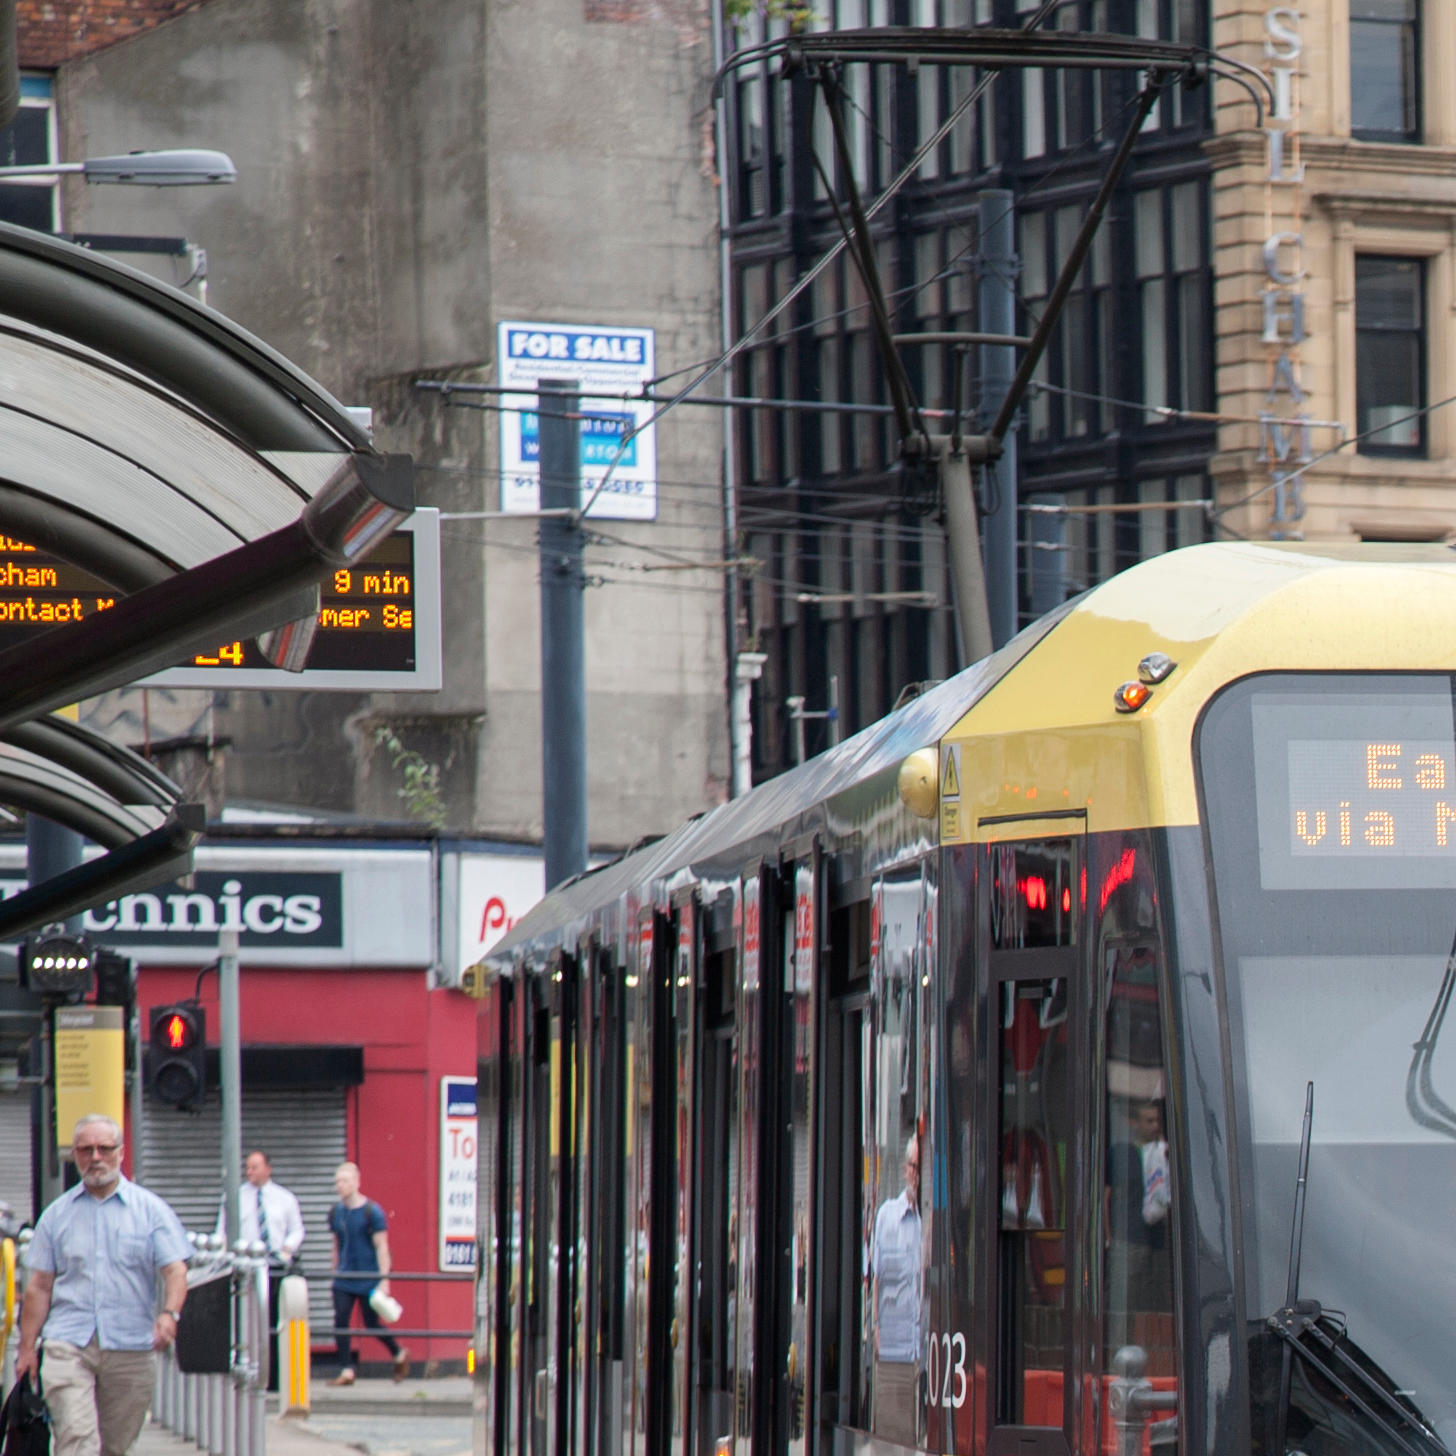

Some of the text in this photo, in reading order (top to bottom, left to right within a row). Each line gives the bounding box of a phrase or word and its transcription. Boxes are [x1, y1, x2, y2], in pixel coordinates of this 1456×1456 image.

[511, 332, 643, 363] FOR SALE
[1256, 231, 1316, 541] CHAMB
[335, 569, 351, 594] 9
[364, 570, 410, 594] min
[319, 608, 370, 628] mer
[195, 641, 244, 666] 4
[1295, 801, 1395, 847] via
[0, 879, 322, 934] chnics
[480, 897, 524, 943] P
[924, 1331, 967, 1409] 023
